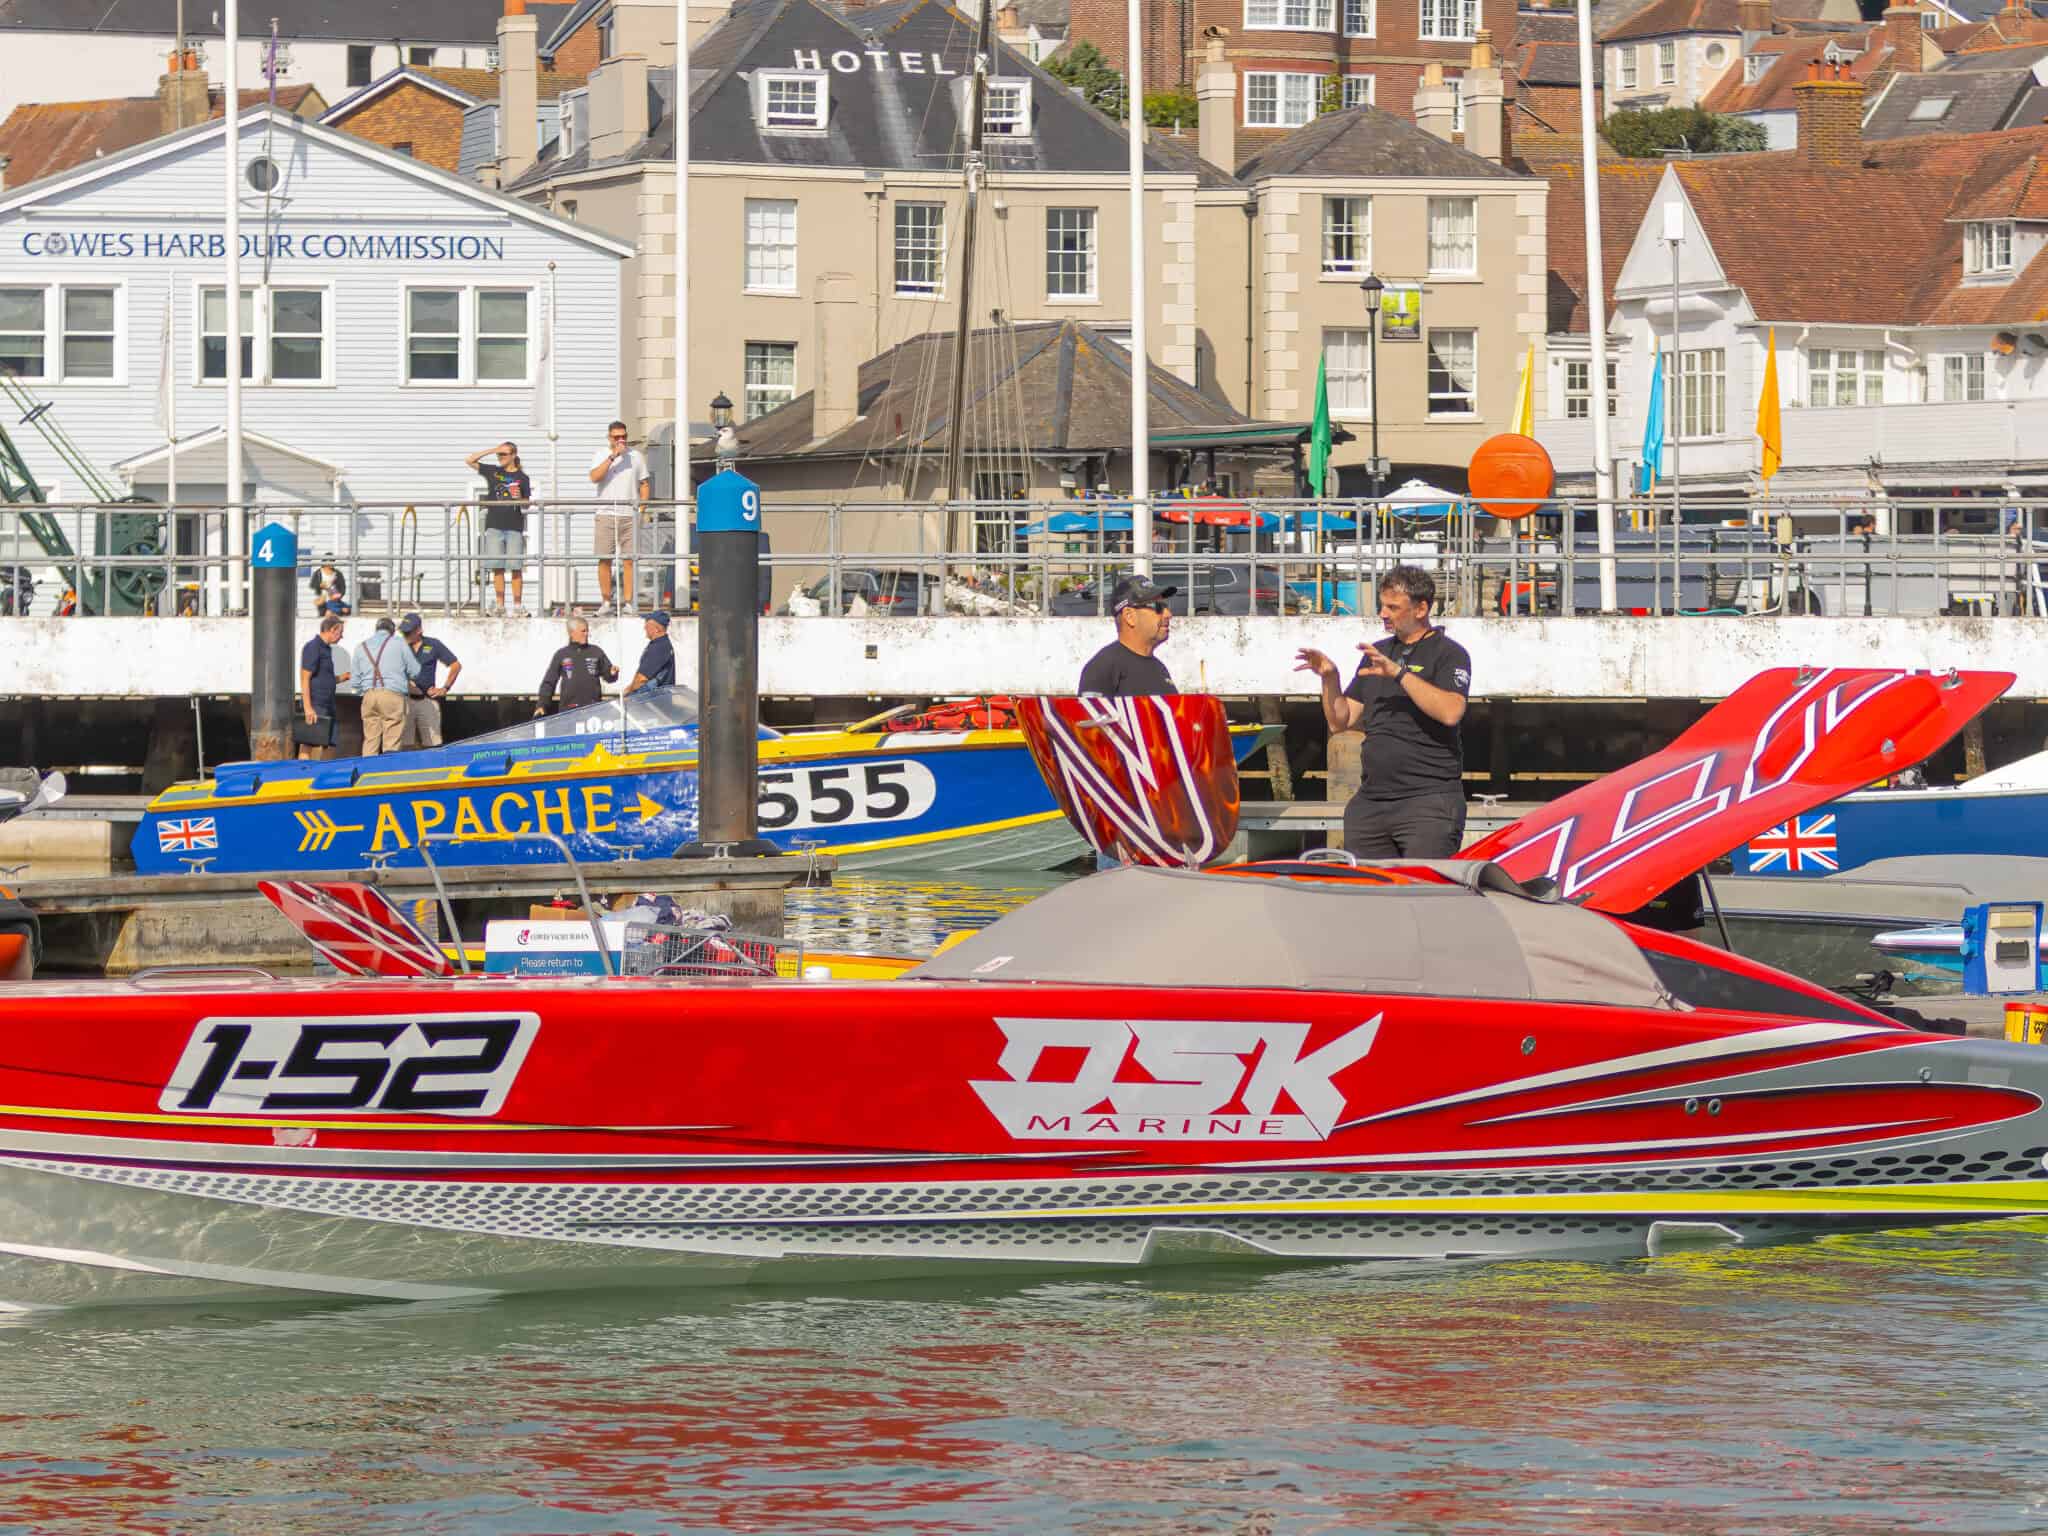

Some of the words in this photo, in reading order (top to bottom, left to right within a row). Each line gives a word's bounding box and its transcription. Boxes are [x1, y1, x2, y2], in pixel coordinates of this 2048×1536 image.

[793, 49, 957, 75] HOTEL
[301, 234, 504, 261] COMMISSION
[742, 490, 757, 521] 9
[258, 539, 275, 562] 4
[757, 763, 910, 828] 555
[370, 785, 617, 851] APACHE
[521, 956, 547, 968] Please
[548, 957, 572, 968] return
[574, 957, 583, 968] to
[177, 1019, 521, 1110] 1-52
[1026, 1114, 1284, 1136] MARINE
